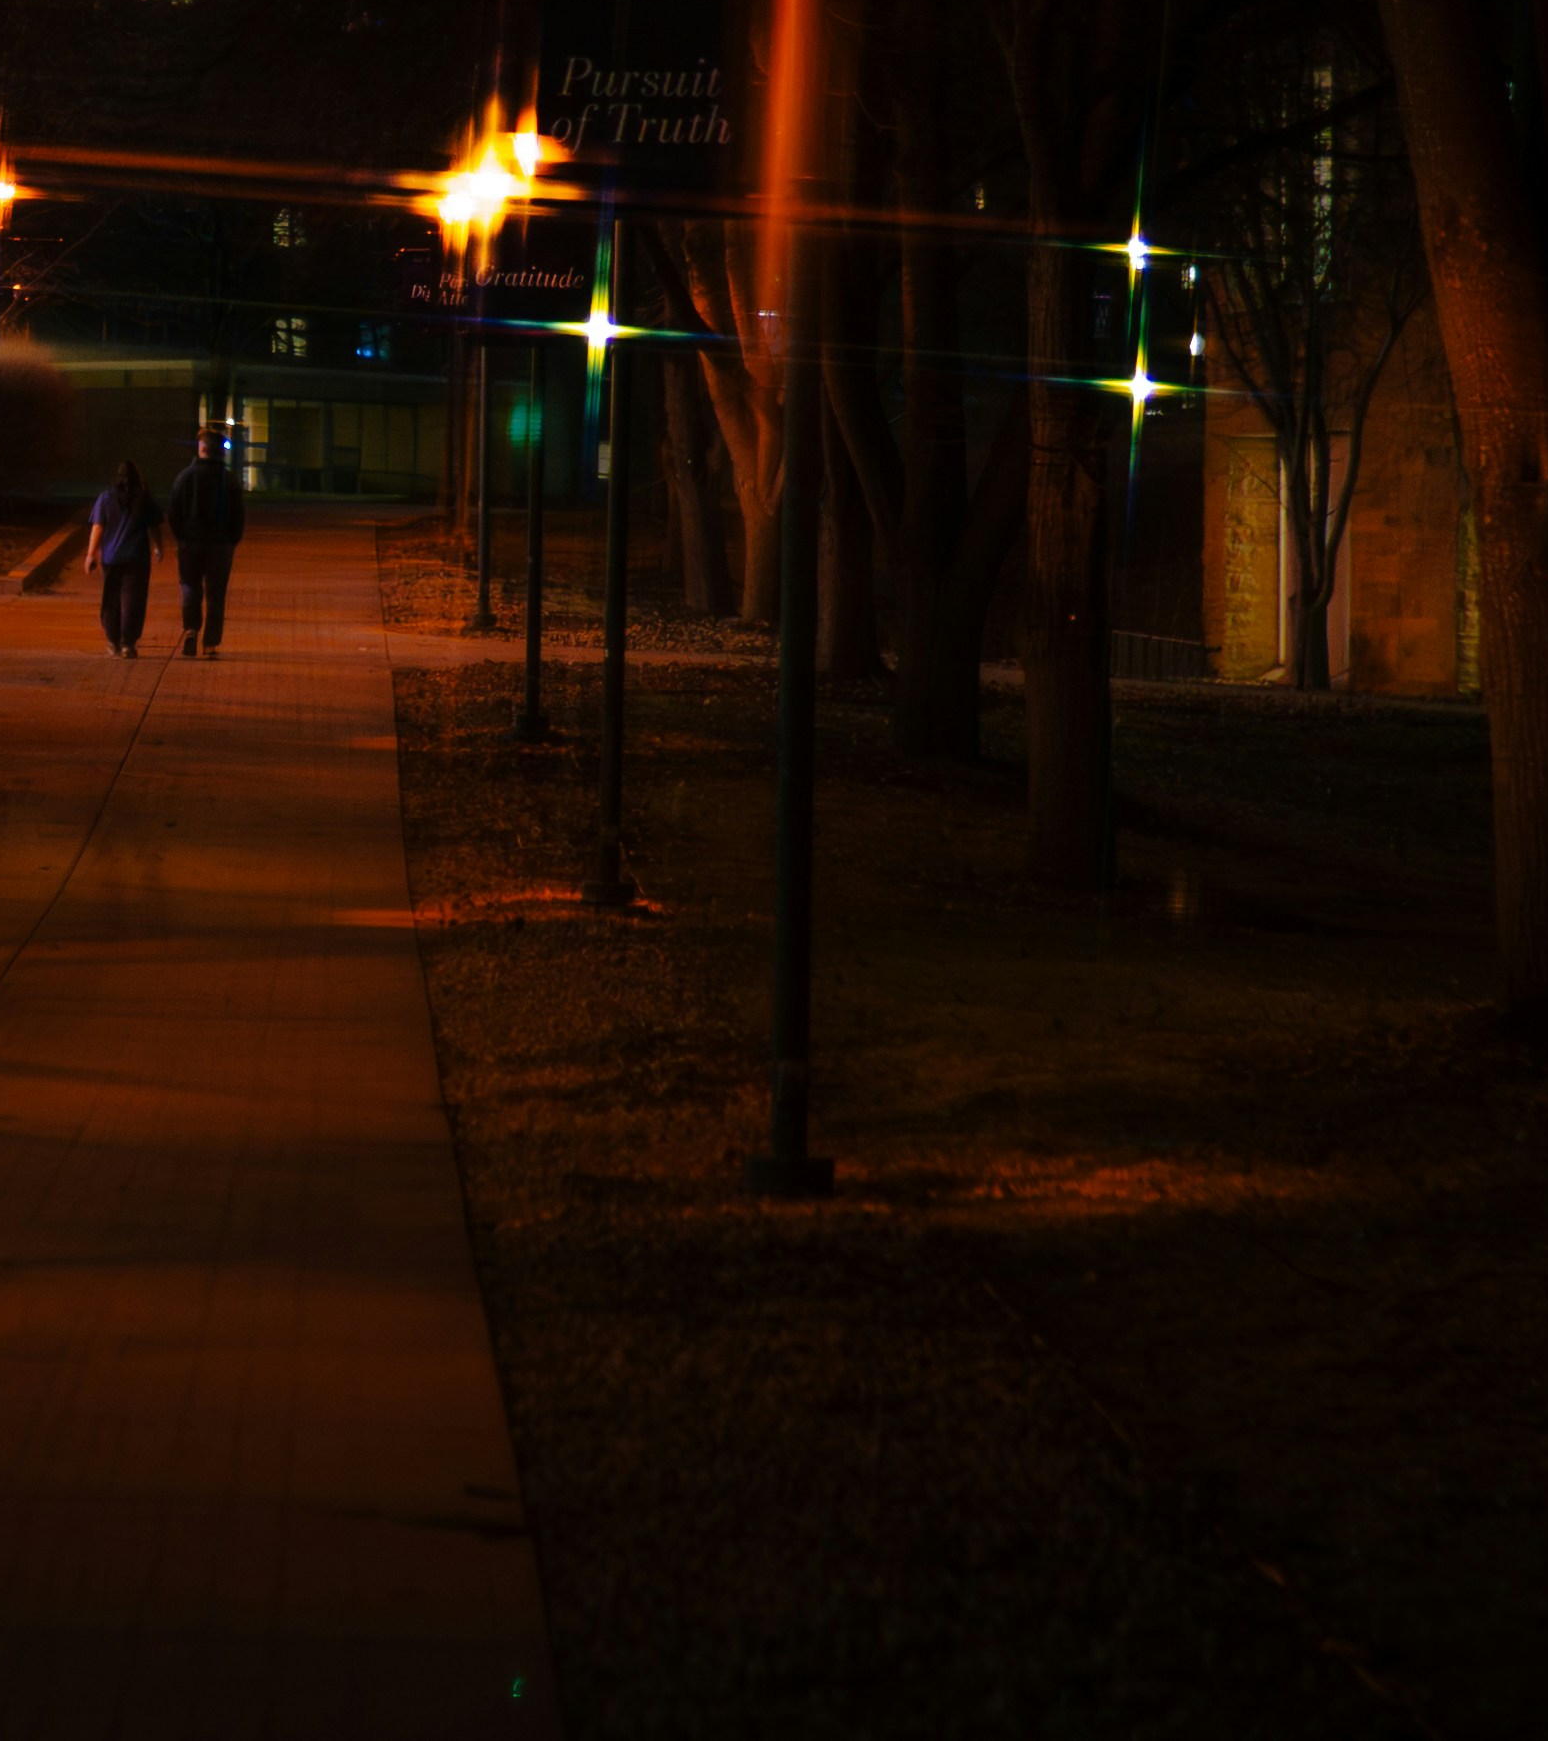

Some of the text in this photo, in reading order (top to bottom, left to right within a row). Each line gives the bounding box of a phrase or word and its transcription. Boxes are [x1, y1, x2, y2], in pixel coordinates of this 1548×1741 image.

[556, 55, 723, 99] Pursuit
[550, 102, 734, 155] of Truth
[474, 263, 586, 290] Gratitude
